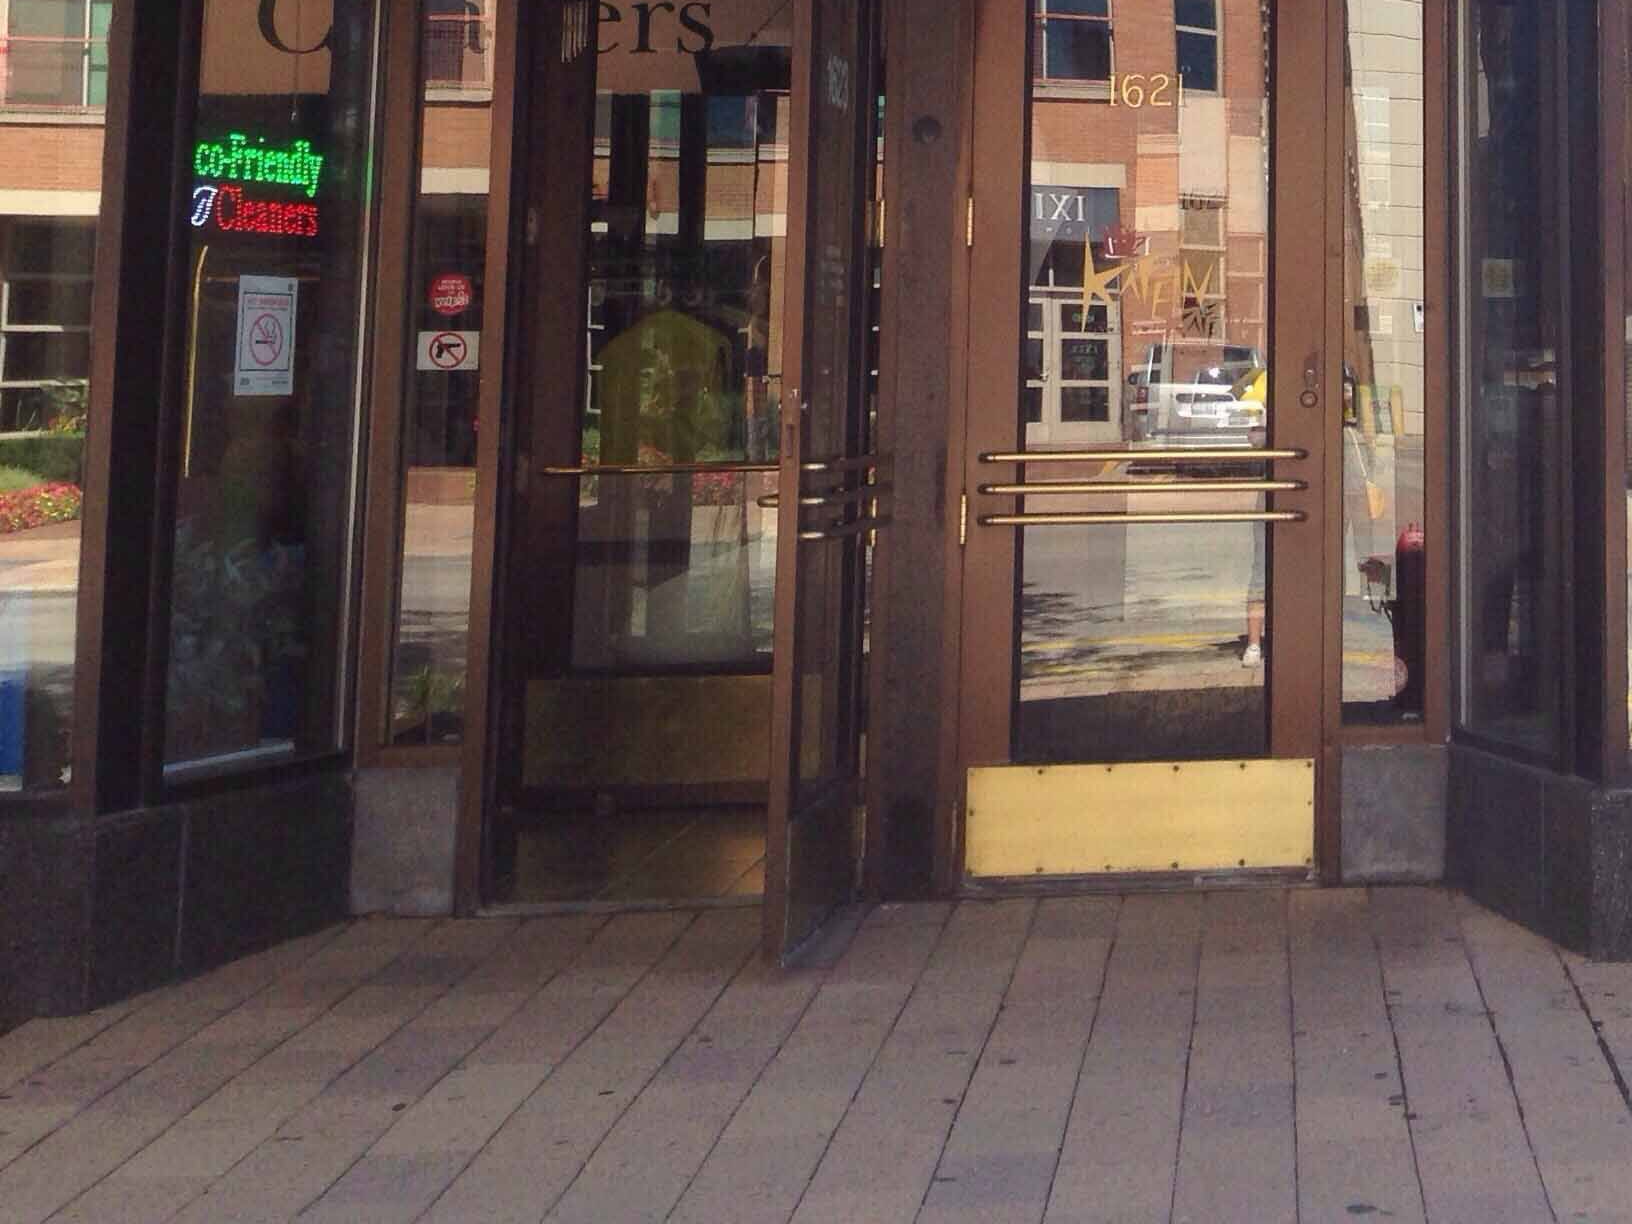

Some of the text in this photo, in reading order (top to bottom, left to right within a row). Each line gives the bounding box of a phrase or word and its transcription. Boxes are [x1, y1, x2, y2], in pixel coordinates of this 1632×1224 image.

[1110, 73, 1184, 108] 1621
[194, 133, 323, 198] co-Friendly
[215, 183, 318, 237] Cleaners
